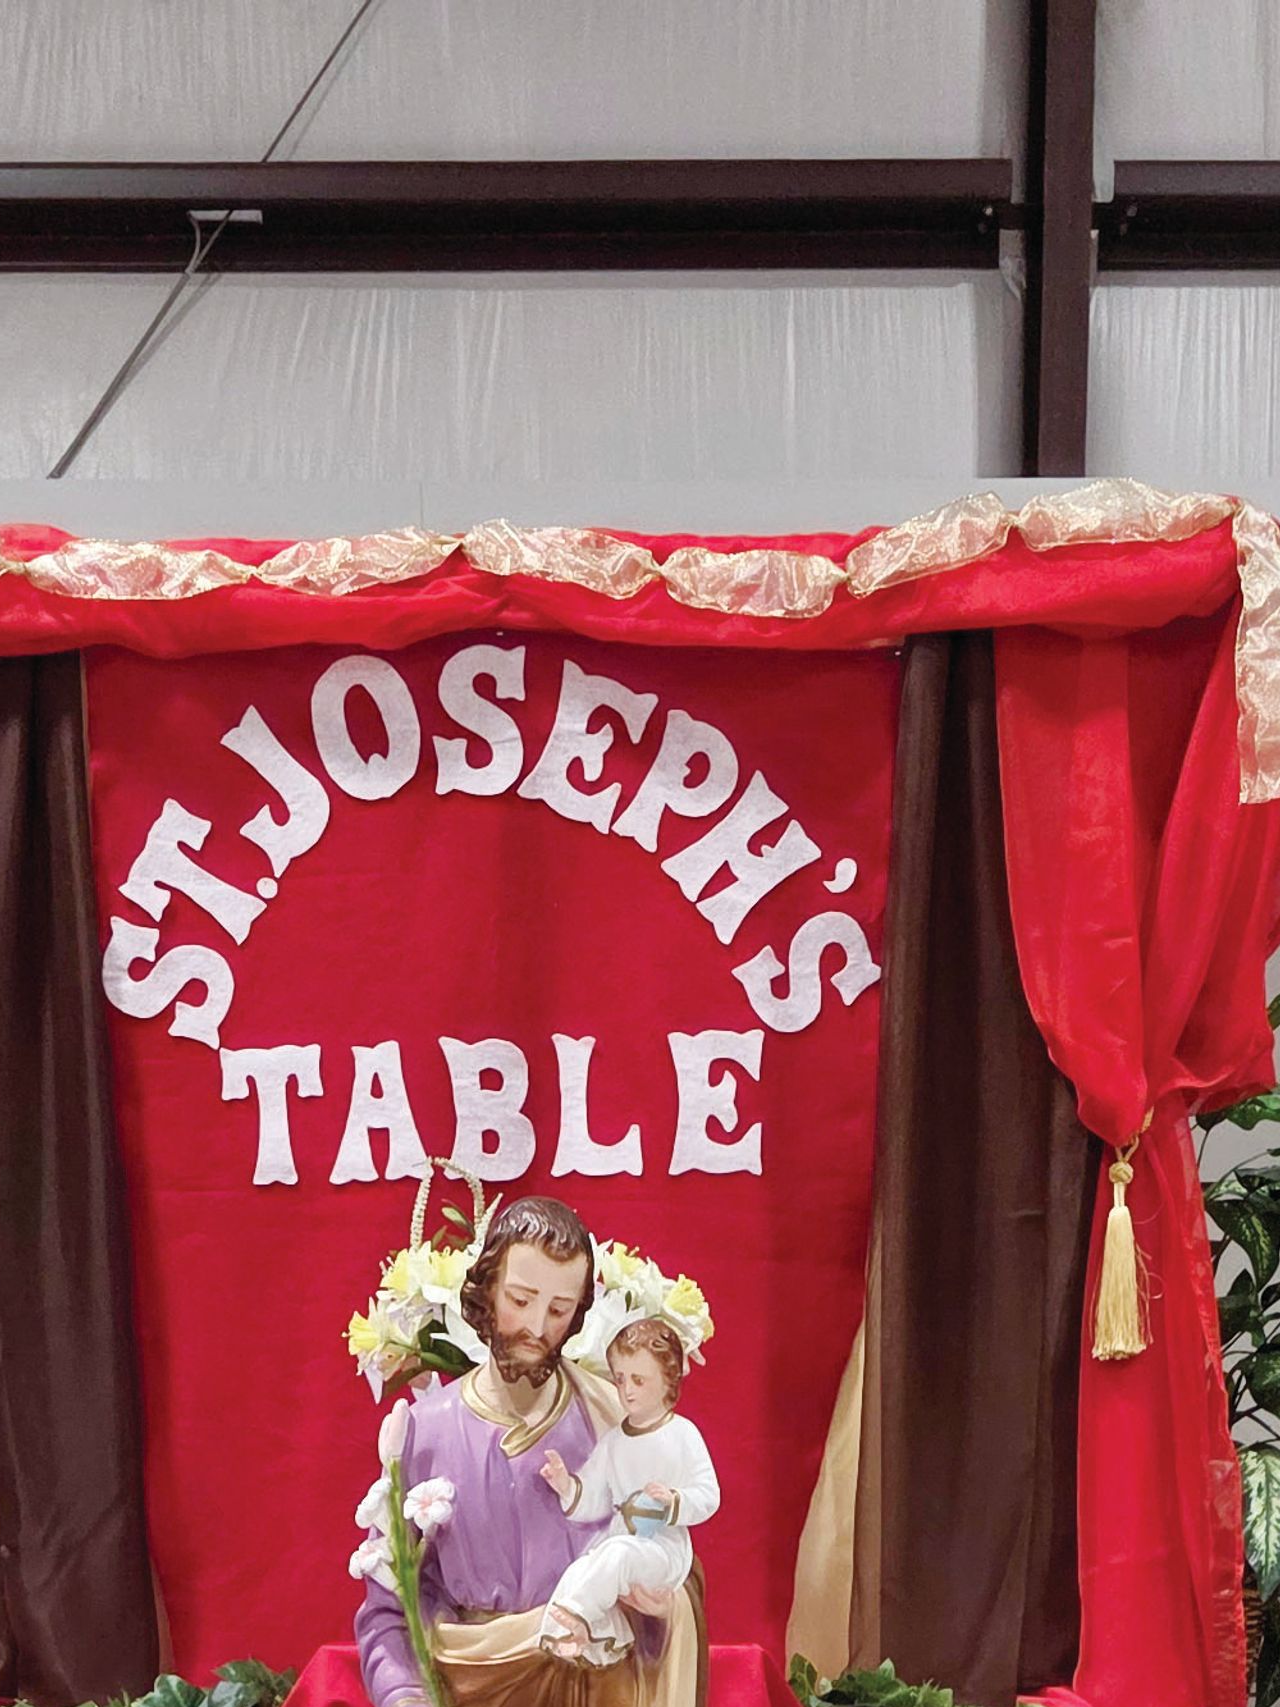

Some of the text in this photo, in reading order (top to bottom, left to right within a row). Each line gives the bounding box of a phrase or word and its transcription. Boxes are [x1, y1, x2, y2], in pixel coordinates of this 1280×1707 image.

[103, 645, 882, 1050] ST. JOSEPH'S
[220, 1029, 765, 1185] TABLE
